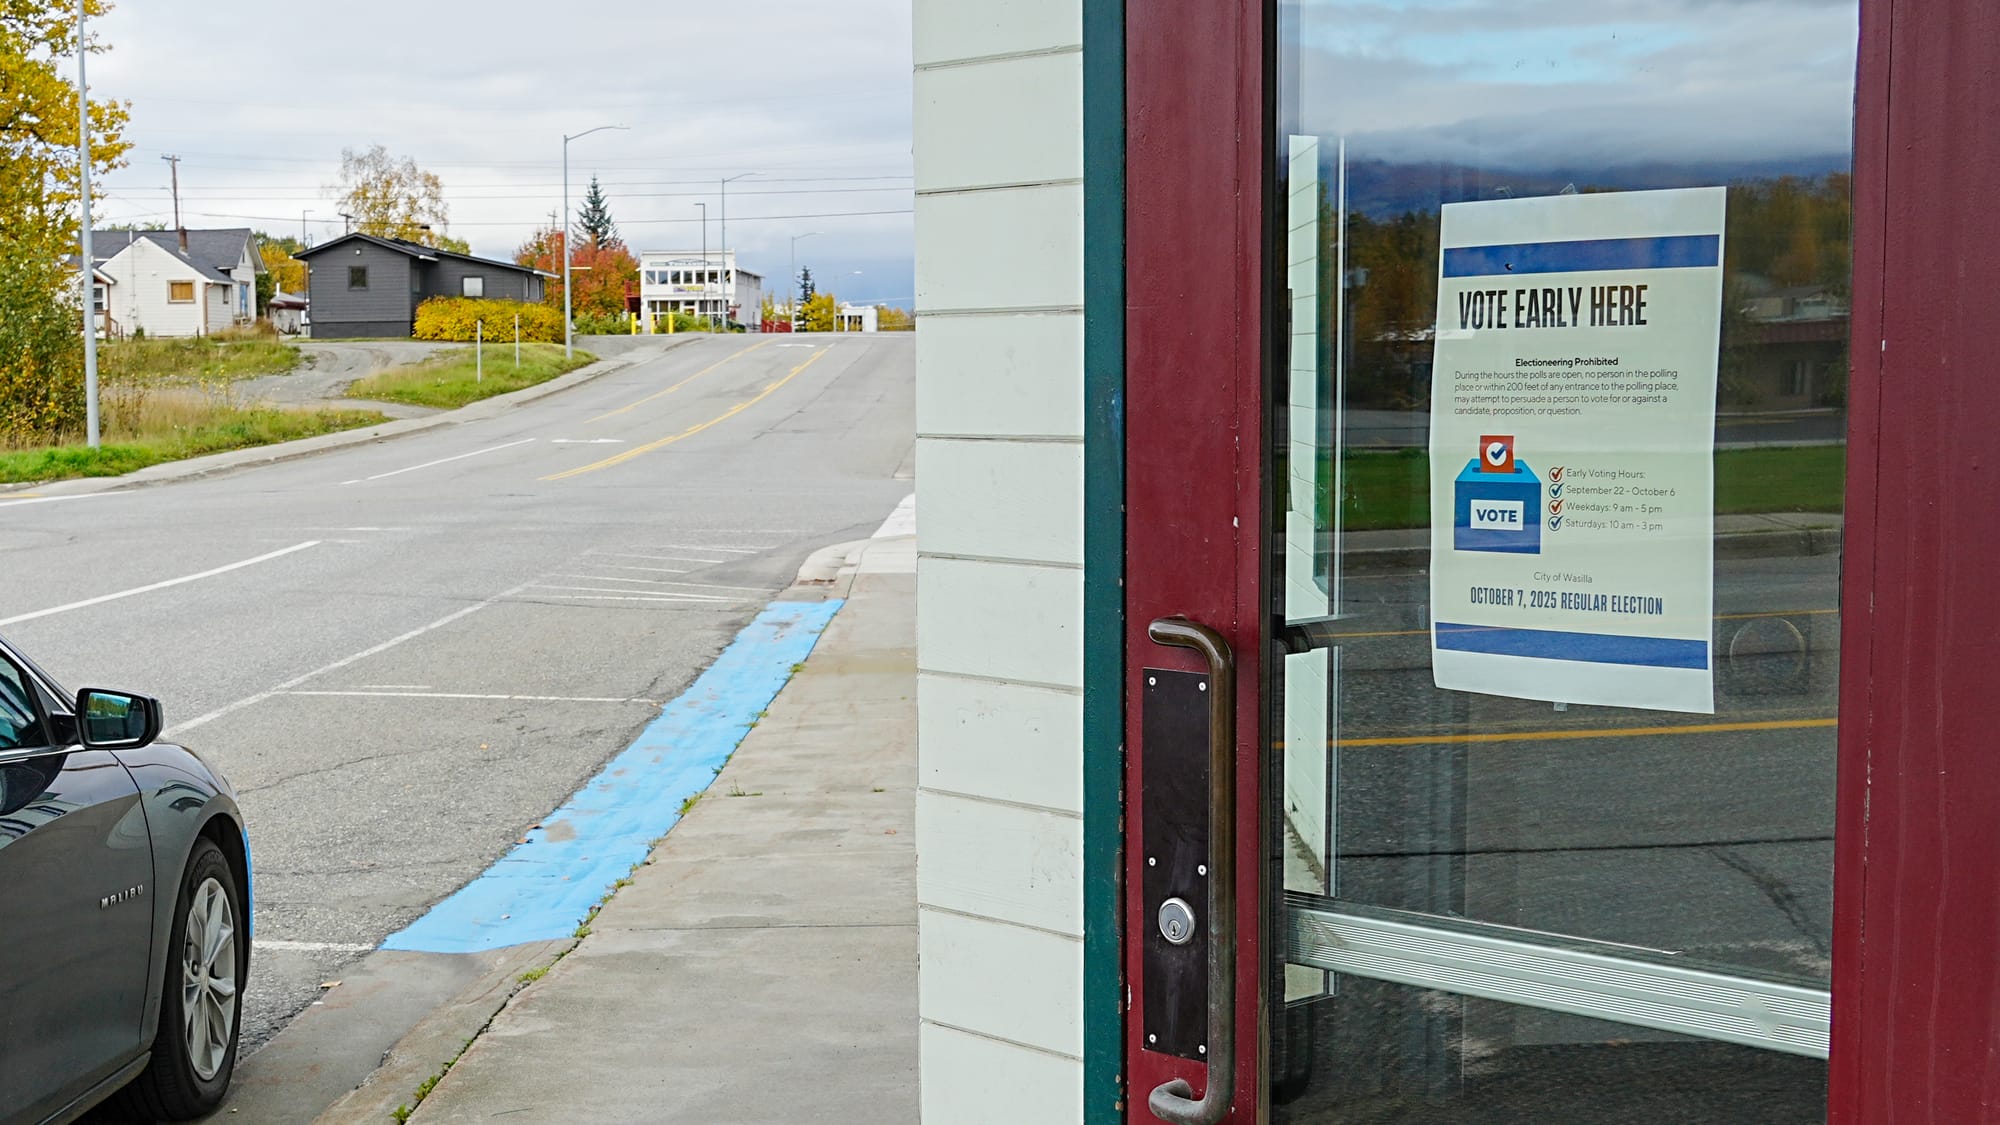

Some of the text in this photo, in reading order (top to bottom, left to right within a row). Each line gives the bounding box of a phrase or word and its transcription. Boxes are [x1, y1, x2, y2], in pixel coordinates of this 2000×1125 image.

[1459, 285, 1648, 329] VOTE EARLY HERE
[1515, 357, 1618, 369] Electioneering Prohibited
[1455, 371, 1479, 381] During
[1481, 371, 1492, 379] the
[1494, 371, 1514, 379] hours
[1530, 371, 1546, 381] polls
[1562, 371, 1583, 380] open,
[1597, 371, 1624, 380] person
[1626, 369, 1633, 377] in
[1650, 369, 1677, 380] polling
[1455, 383, 1474, 392] place
[1484, 383, 1505, 391] within
[1507, 383, 1523, 391] 200
[1525, 383, 1539, 391] feet
[1550, 384, 1564, 392] any
[1565, 383, 1599, 391] entrance
[1611, 382, 1625, 390] the
[1626, 382, 1653, 392] polling
[1655, 382, 1679, 392] place,
[1471, 395, 1500, 404] attempt
[1511, 395, 1546, 404] persuade
[1553, 396, 1579, 404] person
[1610, 394, 1621, 402] for
[1632, 395, 1660, 404] against
[1455, 407, 1491, 416] candidate,
[1493, 407, 1536, 416] proposition,
[1547, 407, 1581, 416] question.
[1567, 469, 1646, 480] Early Voting Hours:
[1566, 485, 1611, 497] September
[1614, 487, 1624, 495] 22
[1632, 487, 1668, 496] October
[1566, 503, 1611, 513] Weekdays:
[1641, 504, 1647, 512] 5
[1649, 507, 1662, 515] pm
[1476, 509, 1517, 522] VOTE
[1566, 519, 1607, 530] Saturdays:
[1610, 520, 1619, 528] 10
[1642, 522, 1647, 530] 3
[1649, 523, 1663, 532] pm
[1534, 572, 1593, 584] City of Wasilla
[1470, 586, 1663, 615] OCTOBER 7, 2025 REGULAR ELECTION
[100, 884, 144, 910] MALIBU
